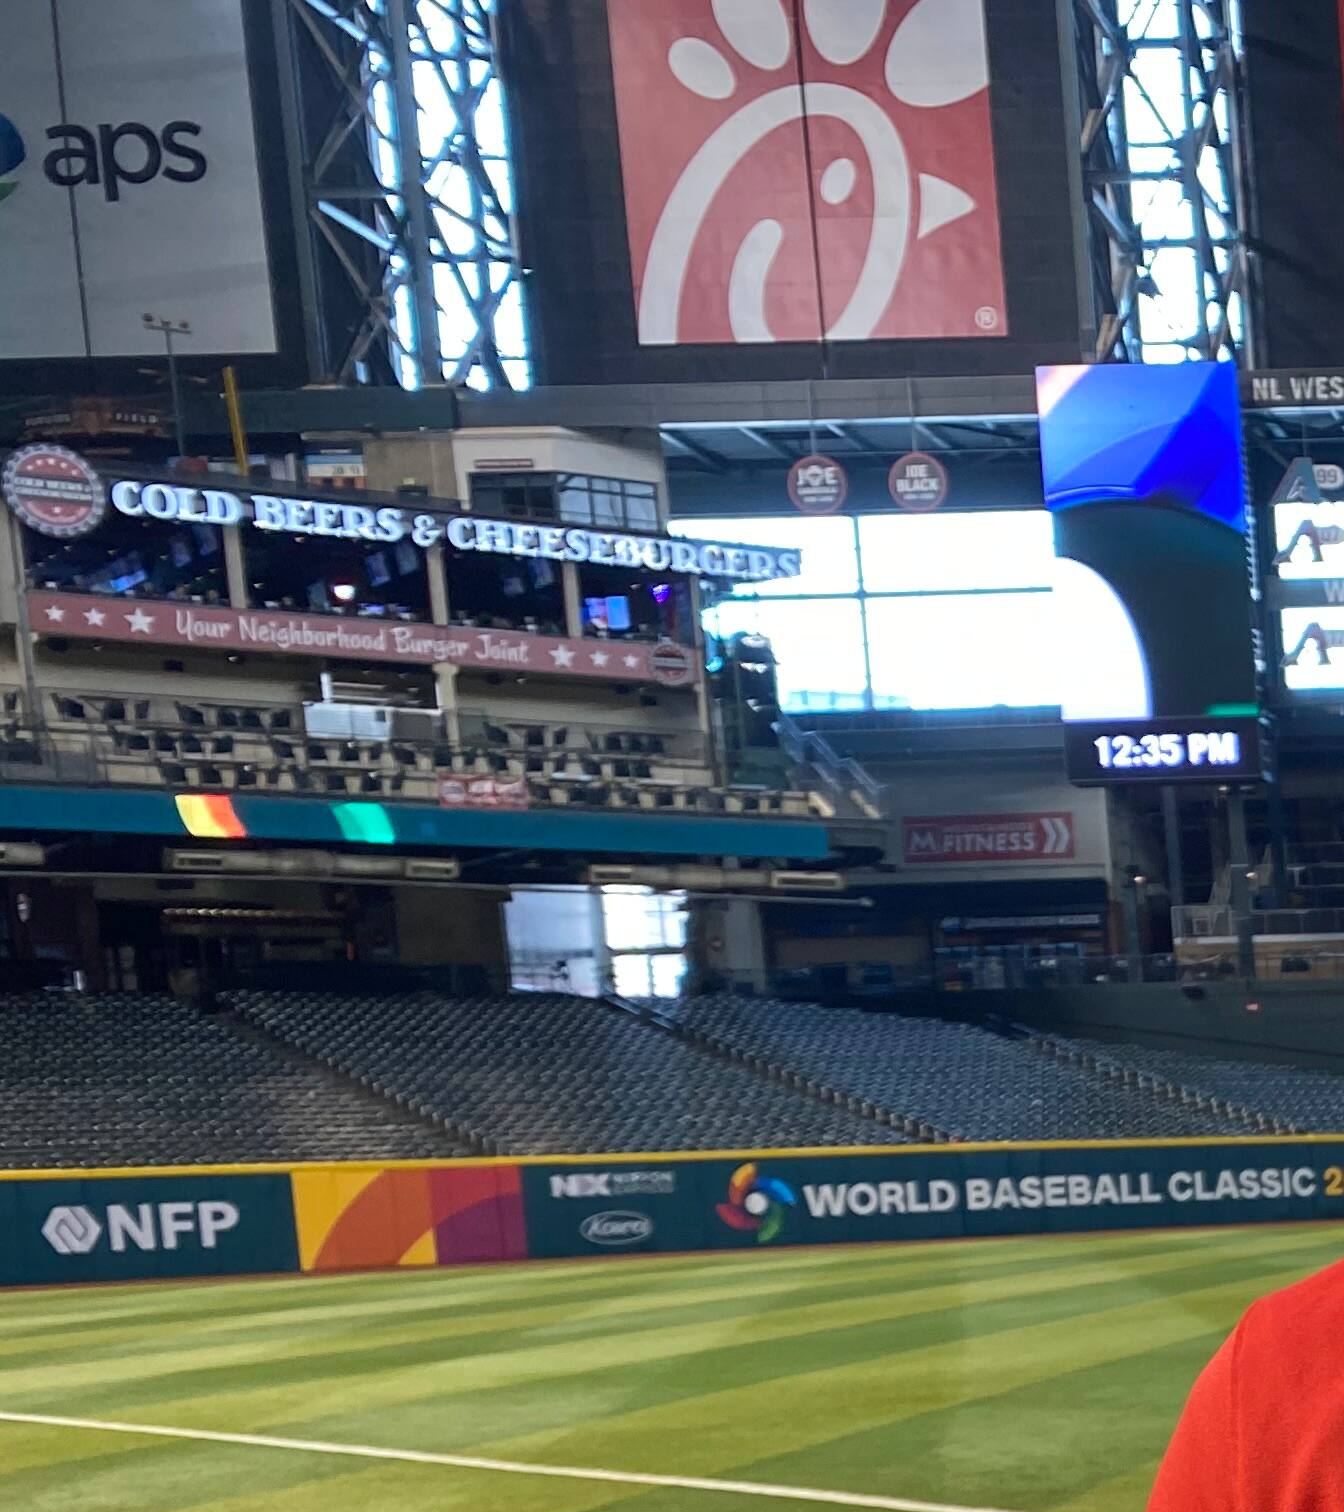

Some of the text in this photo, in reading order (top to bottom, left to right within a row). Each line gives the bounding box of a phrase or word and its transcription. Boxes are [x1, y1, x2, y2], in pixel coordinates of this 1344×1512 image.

[43, 119, 208, 203] aps
[1252, 376, 1285, 401] NL
[796, 464, 839, 487] JOE
[895, 478, 940, 492] BLACK
[905, 464, 929, 478] JOE
[1315, 467, 1338, 484] 99
[111, 480, 244, 525] COLD
[250, 494, 405, 542] BEERS
[411, 514, 443, 547] &
[447, 516, 801, 580] CHEESEBURGERS
[175, 609, 531, 663] Your Neighborhood Burger Joint
[1093, 732, 1240, 768] 12:35 PM
[943, 831, 1037, 852] FITNESS
[802, 1178, 957, 1219] WORLD
[965, 1172, 1162, 1212] BASEBALL
[1168, 1166, 1317, 1202] CLASSIC
[106, 1200, 241, 1252] NFP
